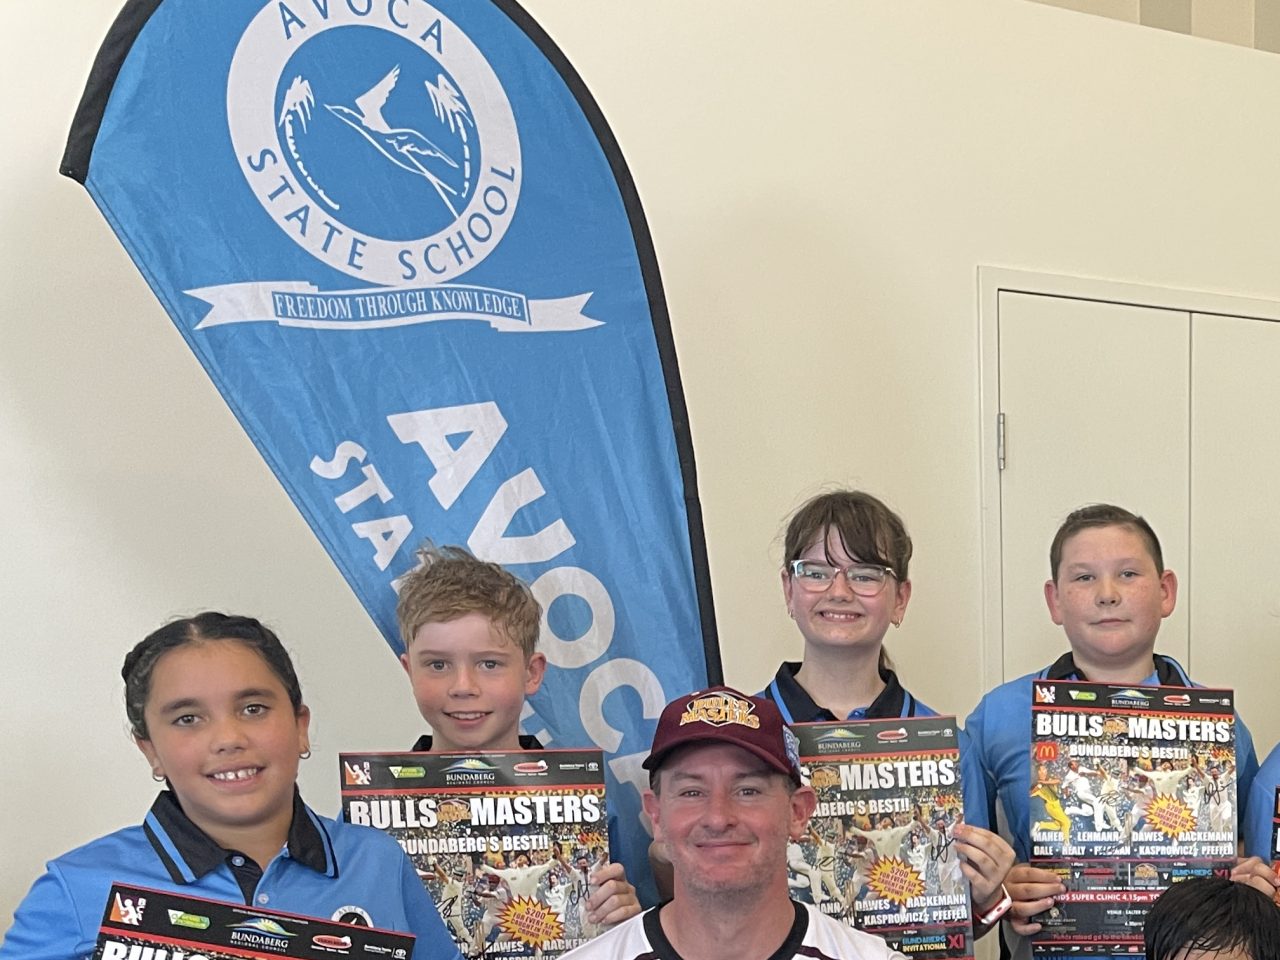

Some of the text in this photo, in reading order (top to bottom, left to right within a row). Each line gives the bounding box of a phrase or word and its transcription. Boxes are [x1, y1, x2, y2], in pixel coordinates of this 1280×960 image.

[247, 148, 516, 280] STATE SCHOOL
[274, 290, 522, 319] FREEDOM THROUGH KNOWLEDGE
[1038, 714, 1230, 743] BULLS MASTERS
[1070, 743, 1149, 758] BUNDABERG'S
[445, 773, 495, 781] BUNDABERG
[838, 759, 955, 790] MASTERS
[349, 795, 600, 829] BULLS MASTERS
[870, 797, 909, 814] BEST!!
[504, 834, 548, 851] BEST!!
[230, 931, 289, 948] BUNDABERG
